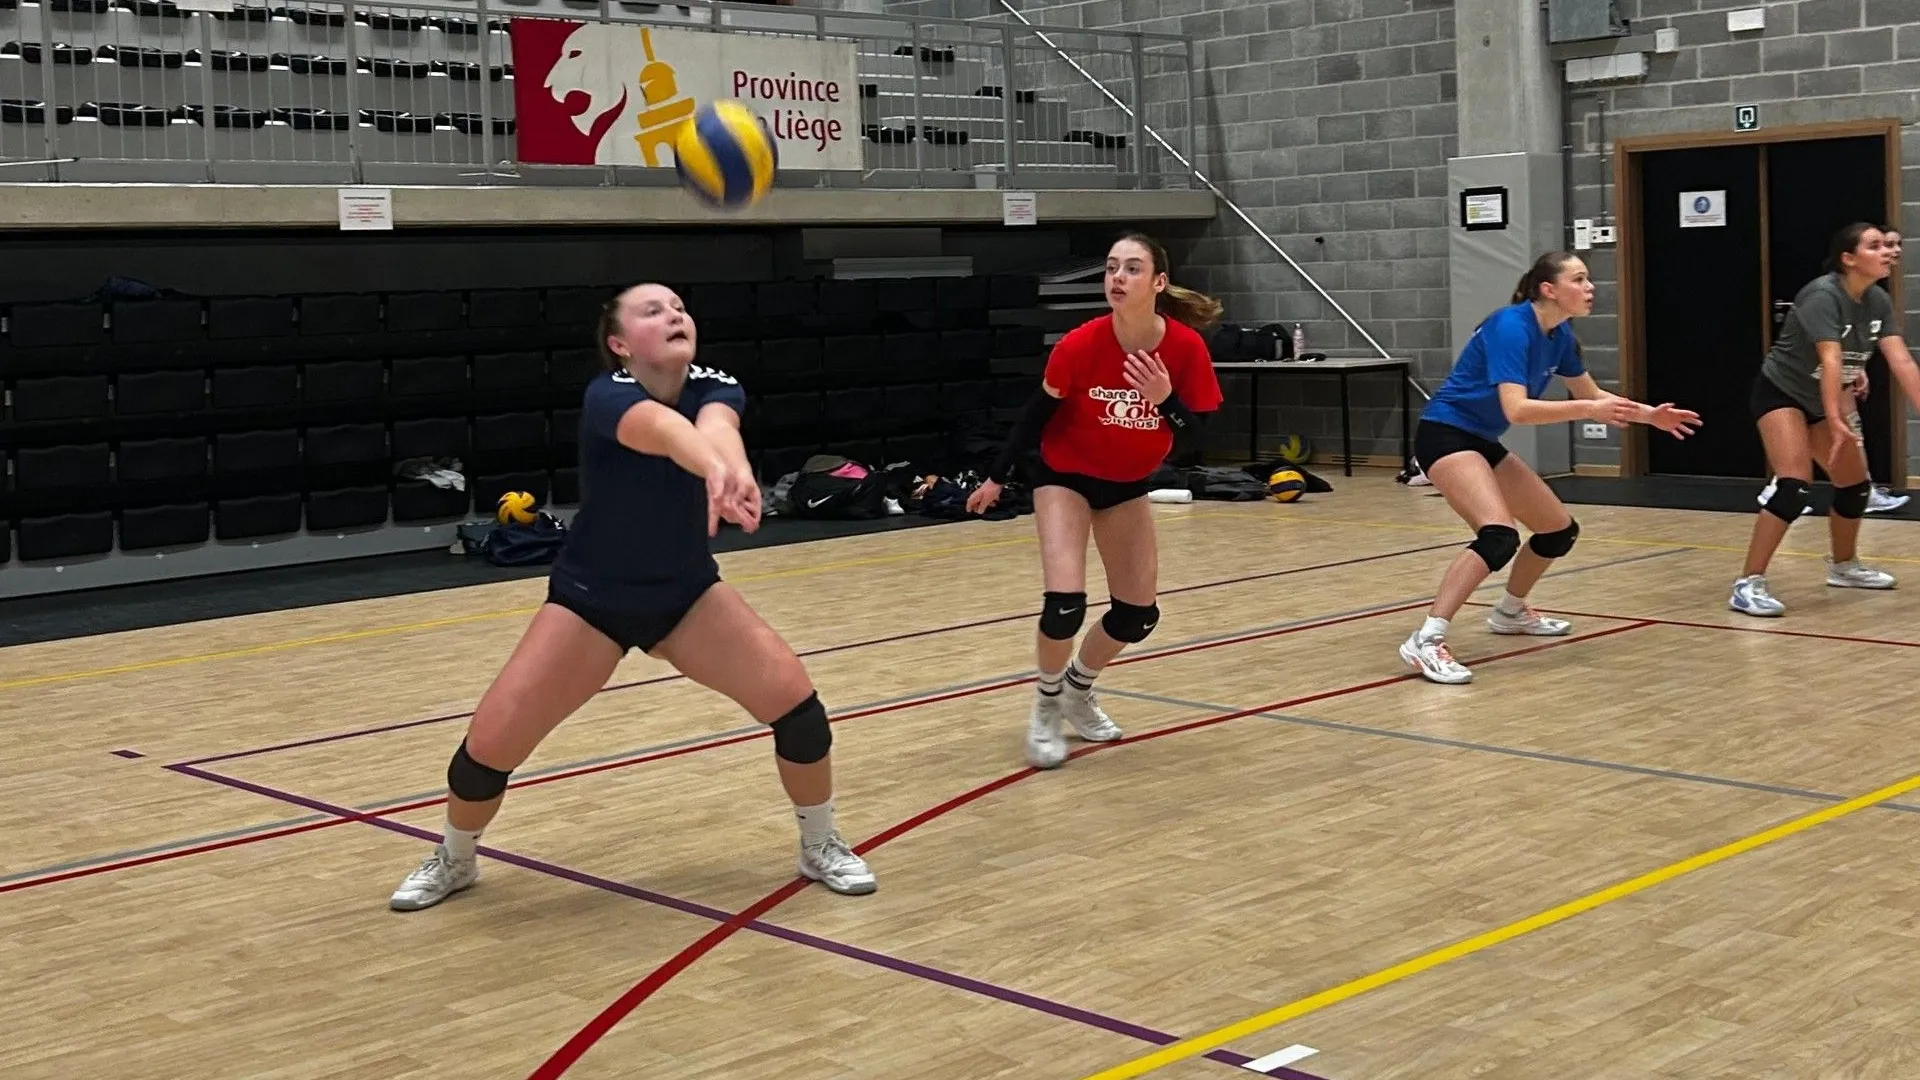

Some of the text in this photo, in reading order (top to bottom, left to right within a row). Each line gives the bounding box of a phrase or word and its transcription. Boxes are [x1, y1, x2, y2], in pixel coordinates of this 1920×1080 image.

[733, 70, 840, 102] Province
[774, 109, 842, 152] Liège
[1091, 388, 1138, 400] share a
[1108, 400, 1159, 419] Cok
[1136, 419, 1159, 428] us!
